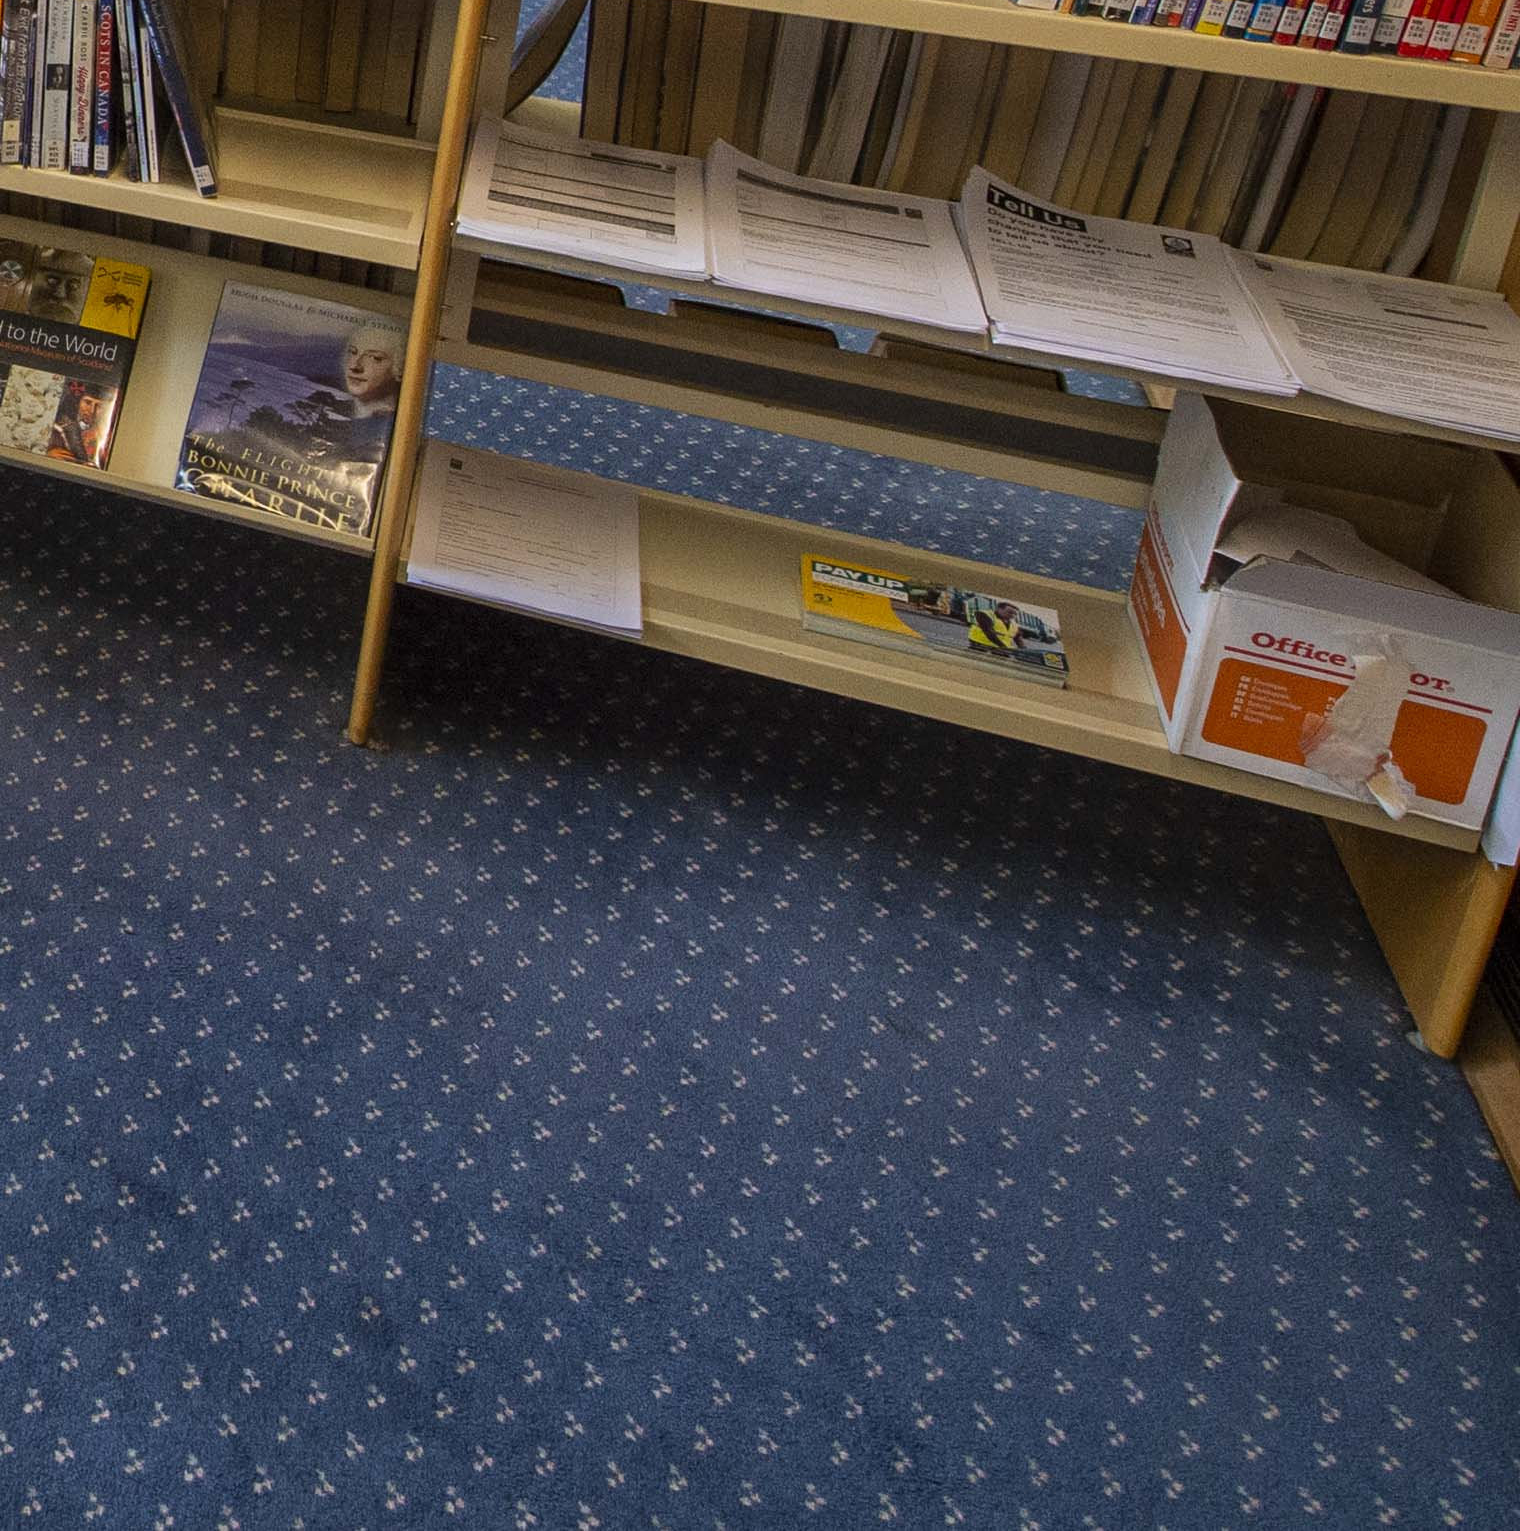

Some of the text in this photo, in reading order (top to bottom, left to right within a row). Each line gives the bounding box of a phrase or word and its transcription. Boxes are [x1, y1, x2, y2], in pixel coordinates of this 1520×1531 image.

[18, 7, 32, 31] Exit
[97, 5, 111, 125] SCOTS IN CANADA
[989, 188, 1081, 230] Tell Us
[7, 324, 25, 341] to
[30, 328, 60, 348] the
[65, 334, 118, 361] World
[188, 449, 355, 508] BONNIE PRINCE
[813, 562, 864, 581] PAY
[867, 575, 905, 589] UP
[1251, 631, 1347, 667] Office
